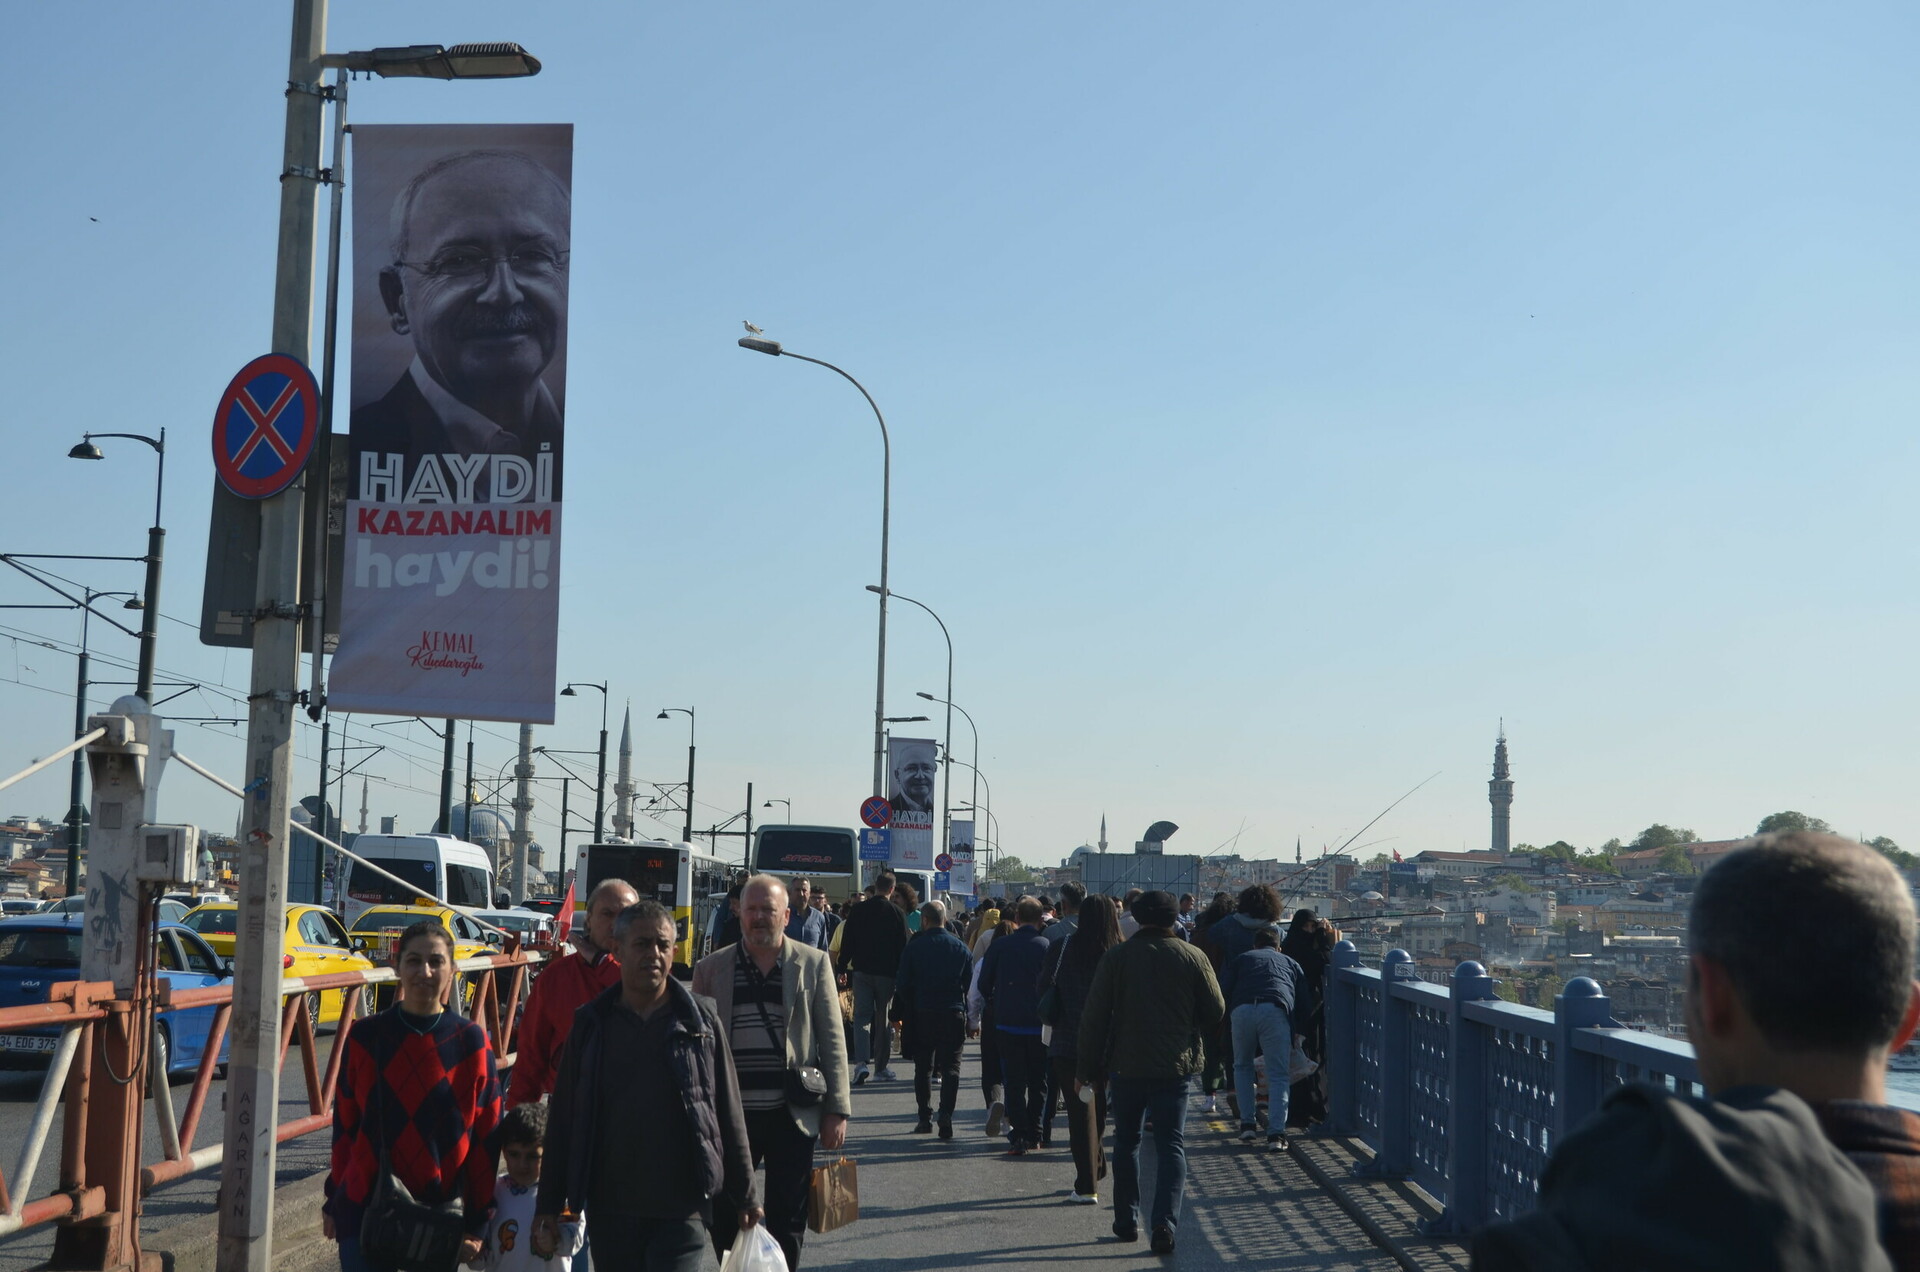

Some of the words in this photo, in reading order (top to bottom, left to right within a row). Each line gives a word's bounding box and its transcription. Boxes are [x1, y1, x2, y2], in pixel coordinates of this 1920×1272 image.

[360, 442, 554, 504] HAYDİ
[358, 507, 552, 536] KAZANALIM
[355, 537, 550, 597] haydi!
[422, 630, 475, 654] KEMAL
[38, 1038, 57, 1050] 375
